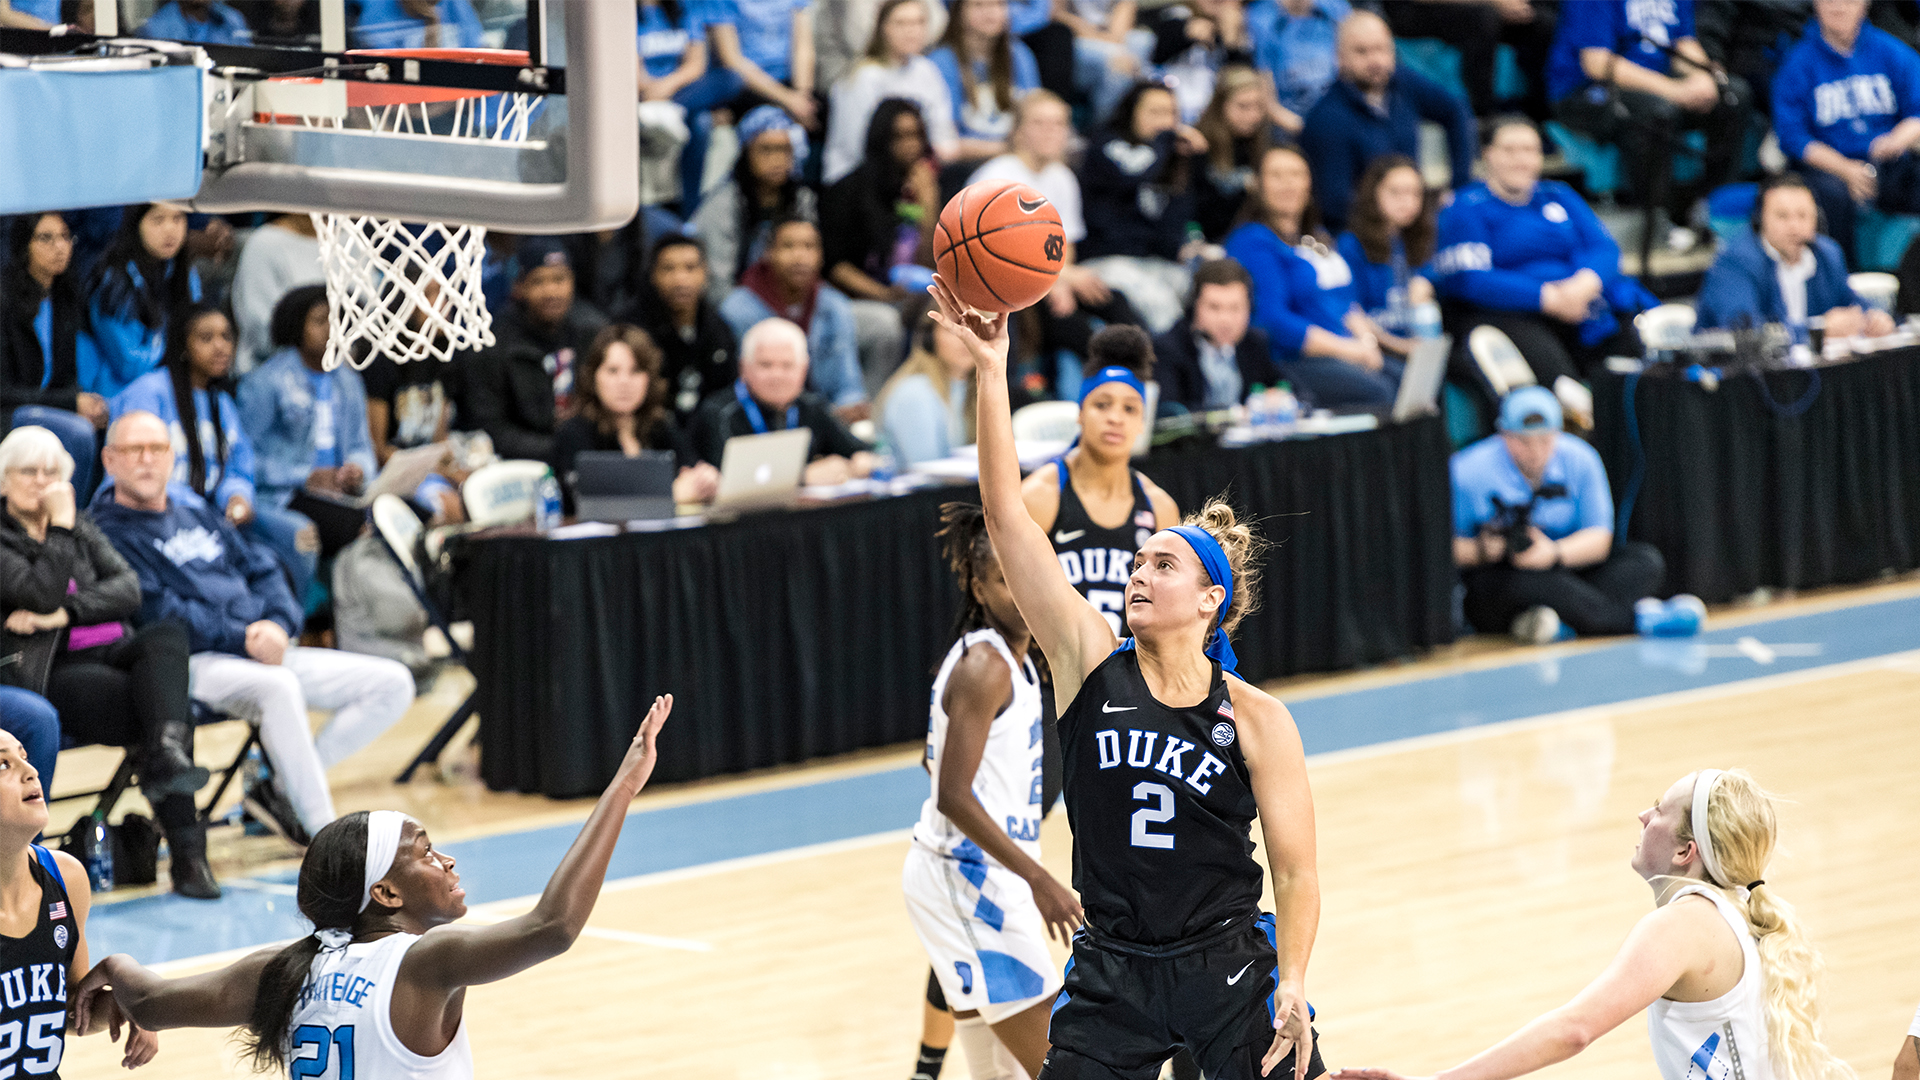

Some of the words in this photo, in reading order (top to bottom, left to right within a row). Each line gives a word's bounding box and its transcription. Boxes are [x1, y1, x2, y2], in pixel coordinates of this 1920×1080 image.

[1058, 547, 1133, 585] DUK
[1095, 728, 1228, 796] DUKE
[1130, 780, 1175, 849] 2
[0, 963, 67, 1013] UKE
[0, 1010, 66, 1075] 25
[291, 1024, 355, 1080] 21
